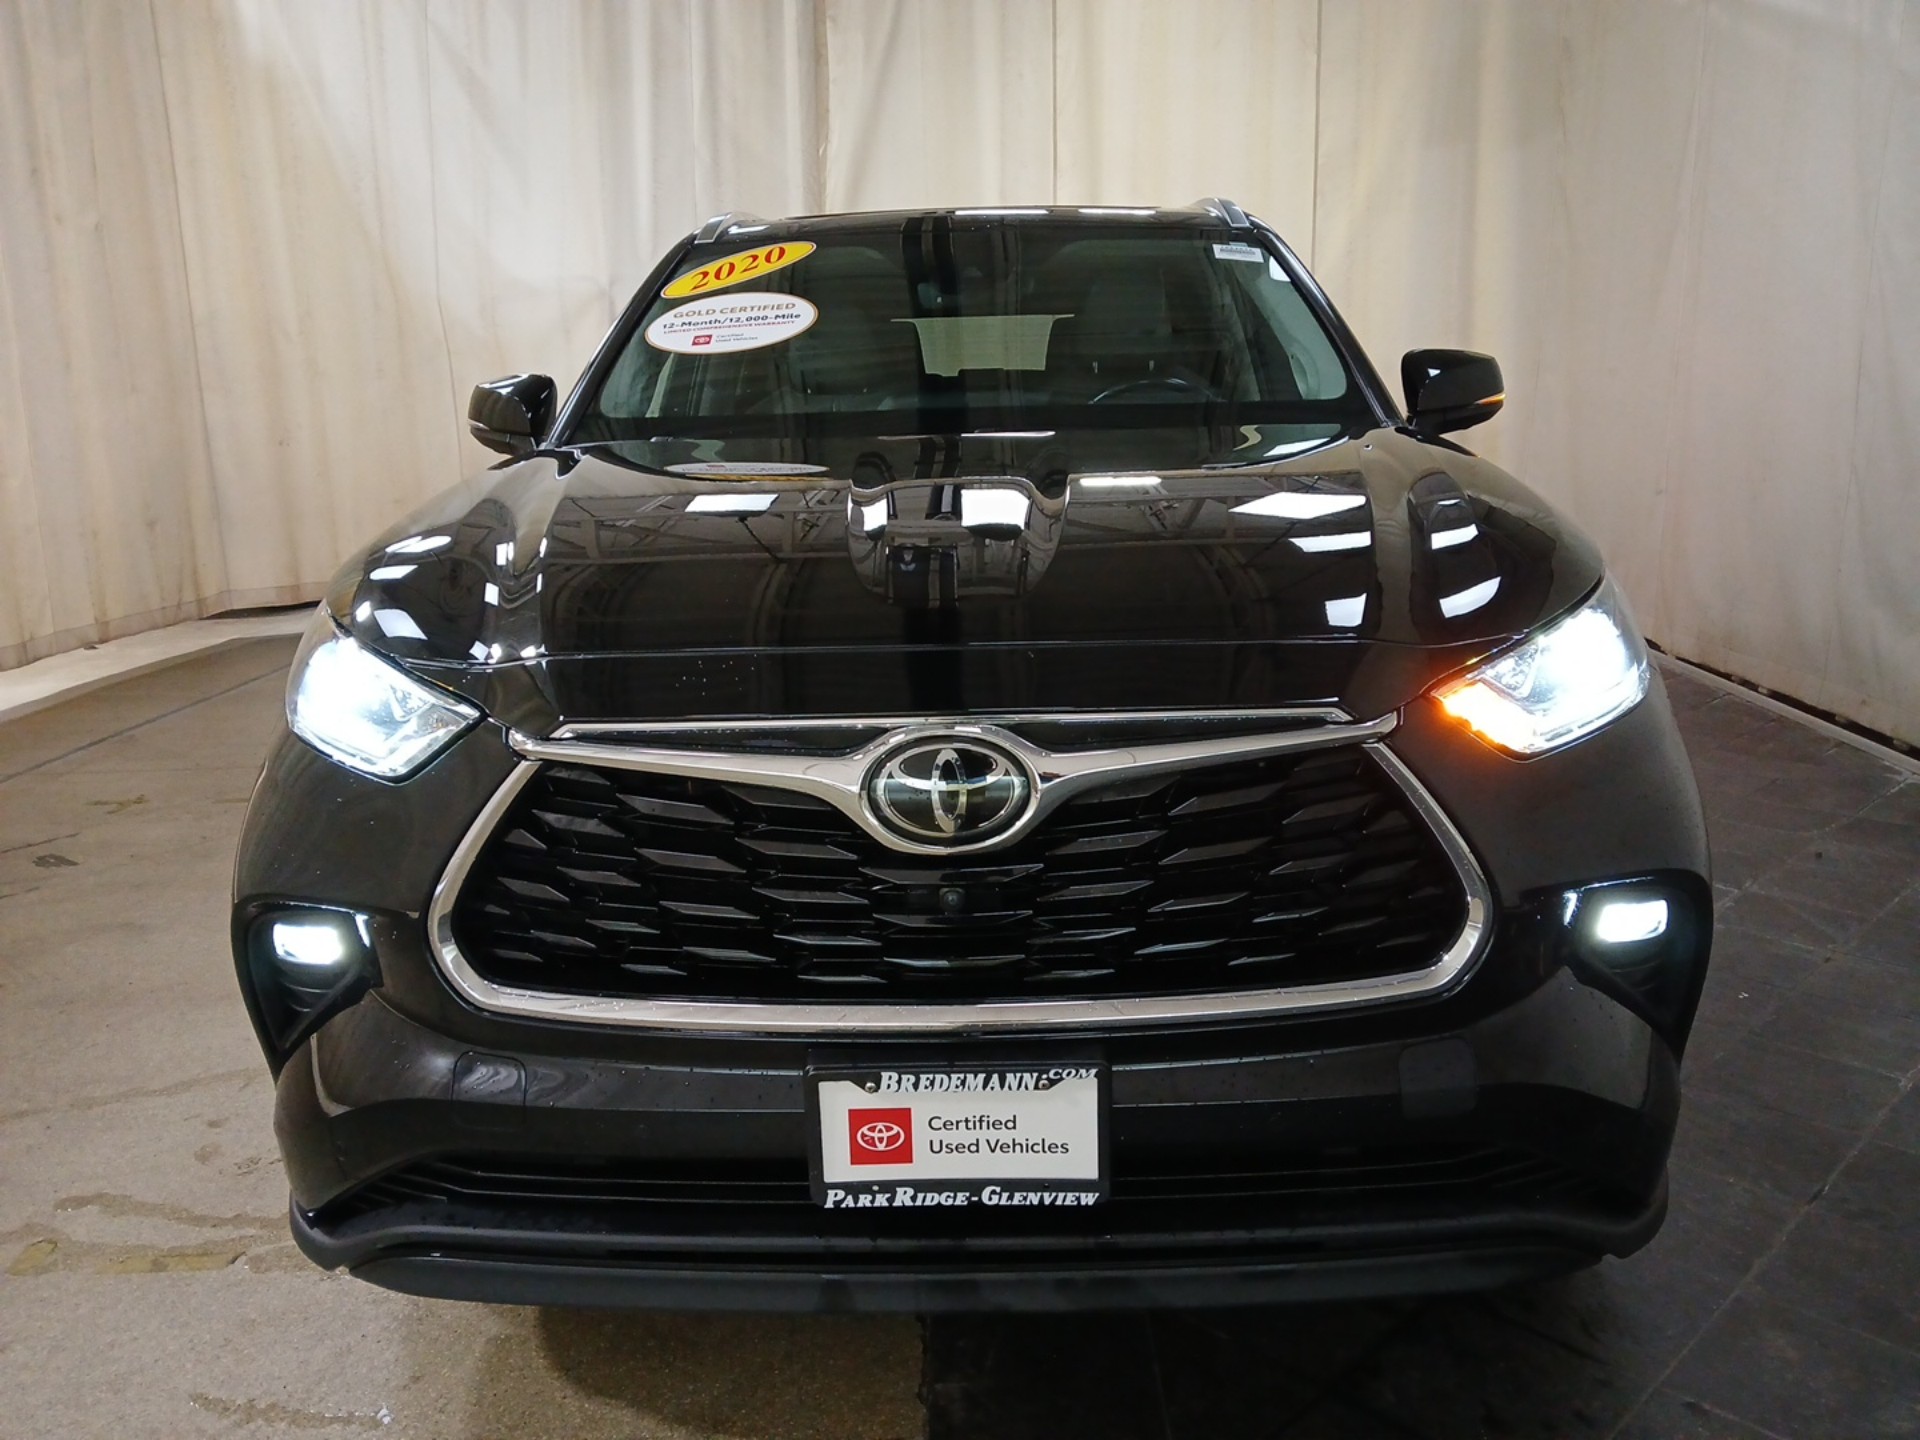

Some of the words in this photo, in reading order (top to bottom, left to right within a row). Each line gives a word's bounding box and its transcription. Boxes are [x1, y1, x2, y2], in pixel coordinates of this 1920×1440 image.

[690, 246, 786, 292] 2020
[673, 308, 717, 319] GOLD
[719, 302, 797, 315] CERTIFIED
[663, 312, 801, 329] 12-Month/12,000-Mile
[927, 1114, 1017, 1132] Certified
[929, 1138, 980, 1154] Used
[985, 1137, 1070, 1154] Vehicles
[824, 1189, 891, 1209] PARK
[892, 1185, 1100, 1207] RIDGE-GLENVIEW
